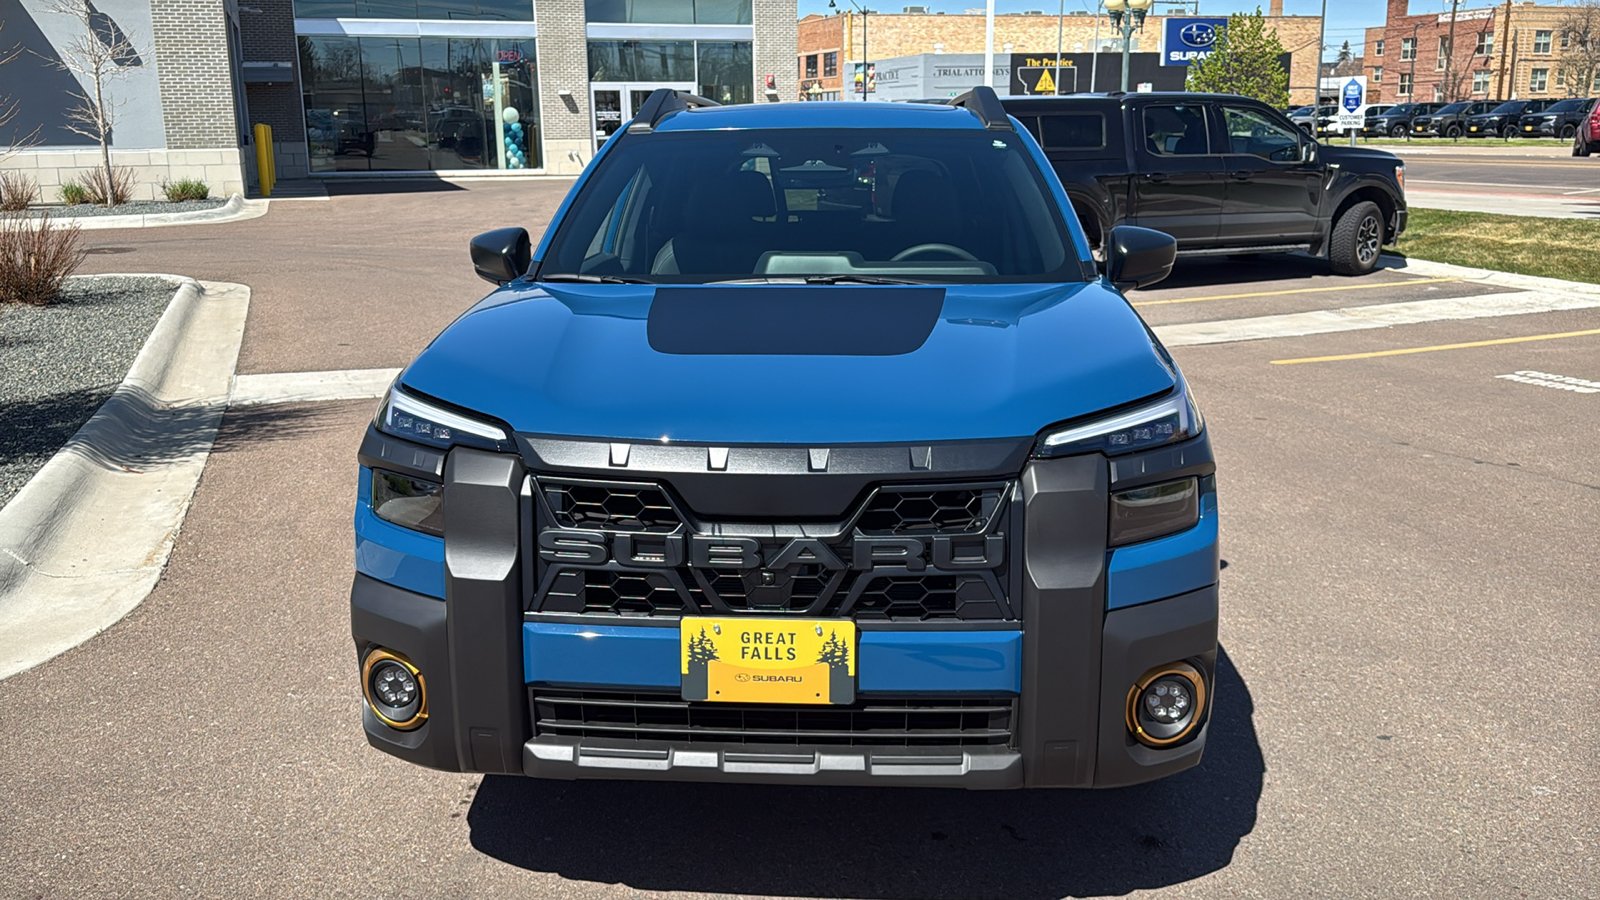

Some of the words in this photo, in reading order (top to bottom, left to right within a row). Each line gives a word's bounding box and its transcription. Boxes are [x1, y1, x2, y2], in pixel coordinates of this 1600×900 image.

[496, 50, 521, 61] OPEN
[1026, 58, 1041, 67] The
[1042, 58, 1074, 67] Pratice
[937, 68, 963, 77] TRIAL
[963, 68, 1010, 77] ATTOEYS
[538, 525, 1006, 571] SUBARU
[740, 631, 797, 645] GREAT
[740, 646, 797, 661] FALLS
[752, 675, 803, 683] SUBARU
